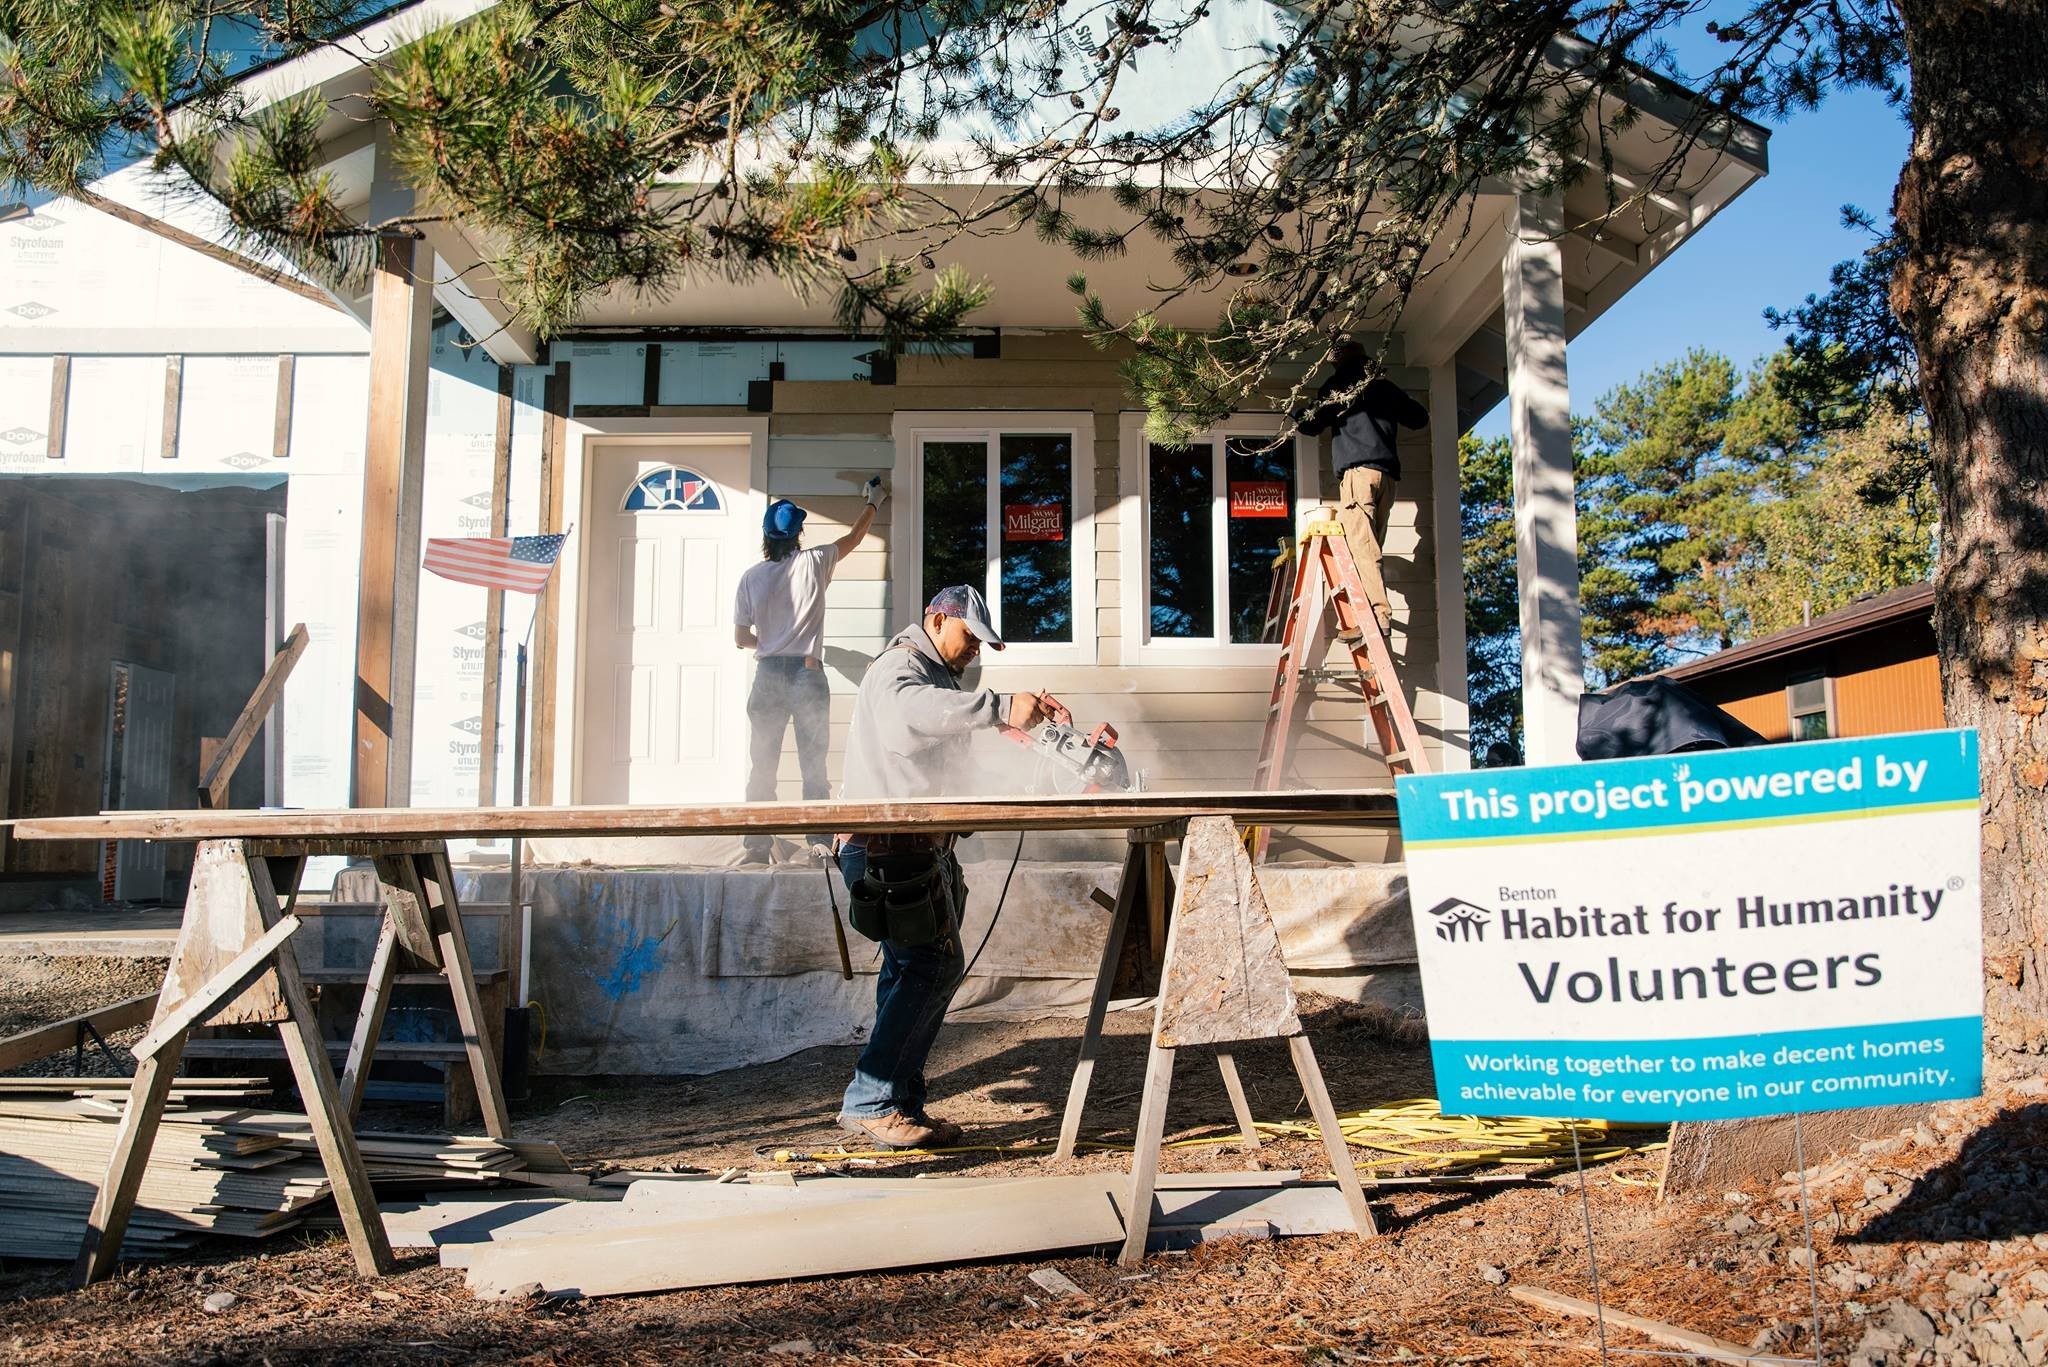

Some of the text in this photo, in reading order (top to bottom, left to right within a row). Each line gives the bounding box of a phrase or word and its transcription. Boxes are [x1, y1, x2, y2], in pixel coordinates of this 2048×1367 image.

[10, 236, 64, 250] Styrofoam
[0, 451, 45, 464] yrofoam
[1234, 490, 1284, 511] Milgard
[1009, 514, 1060, 534] Milgard
[1440, 754, 1928, 823] This project powered by
[1499, 887, 1556, 902] Benton
[1501, 905, 1649, 939] Habitat
[1663, 902, 1721, 934] for
[1518, 952, 1882, 1004] Volunteers
[1465, 1038, 1945, 1077] Working together to make decent homes
[1460, 1067, 1956, 1107] achievable for everyone in our community.
